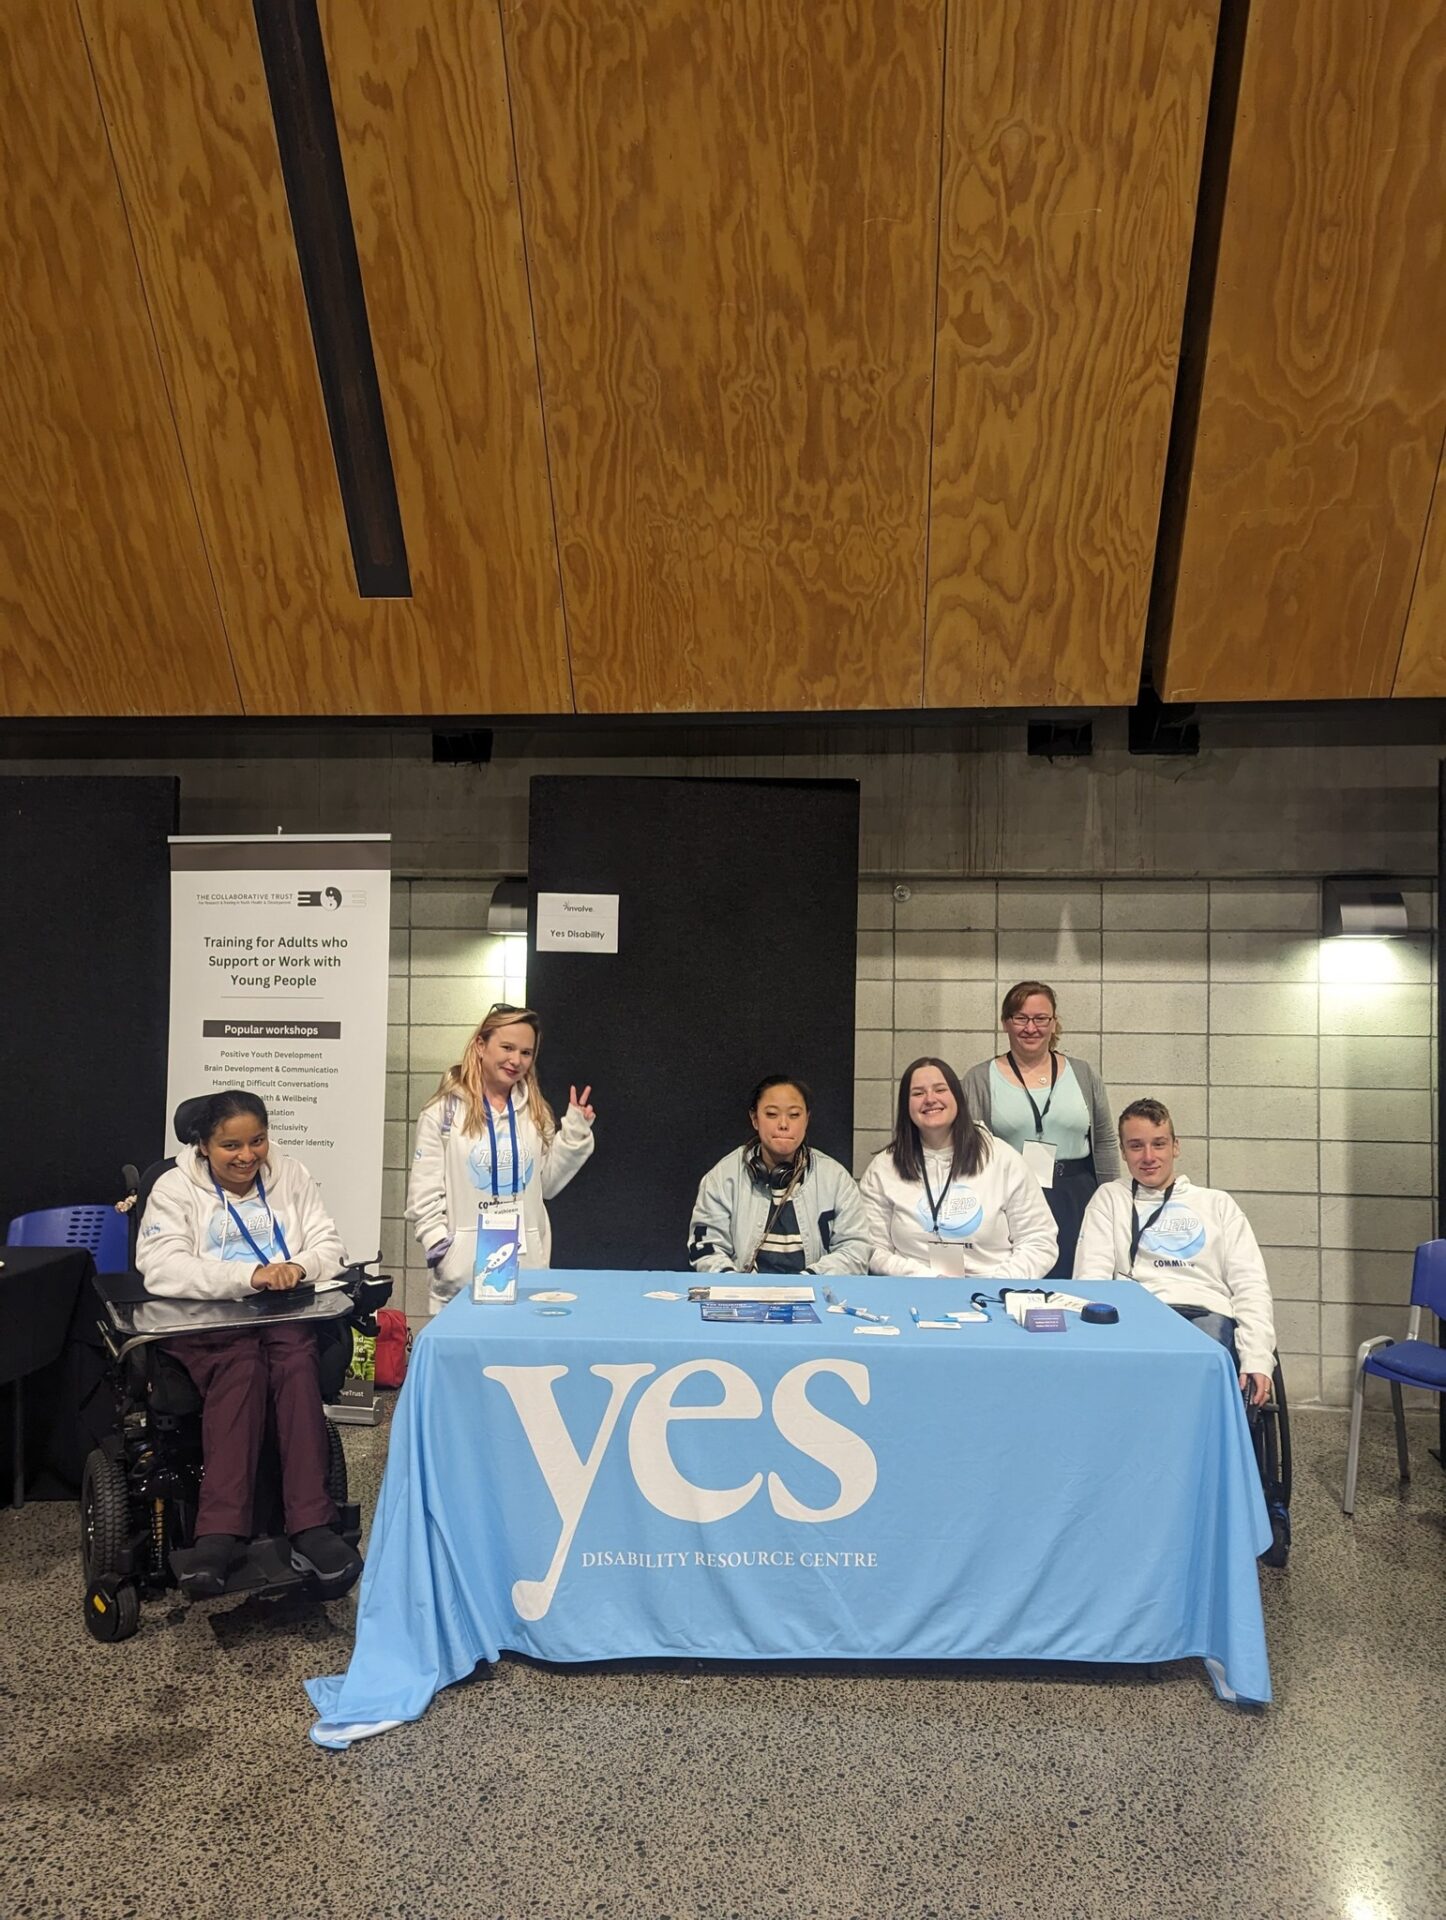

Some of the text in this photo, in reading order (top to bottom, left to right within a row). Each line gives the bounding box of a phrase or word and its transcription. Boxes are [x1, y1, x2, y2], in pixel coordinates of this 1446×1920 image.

[550, 929, 565, 938] Yes
[204, 936, 348, 950] Training for Adults who
[208, 955, 341, 969] Support or Work with
[230, 974, 317, 988] Young People
[224, 1024, 318, 1037] Popular workshops
[220, 1050, 322, 1060] Positive Youth Development
[204, 1064, 339, 1073] Brain Development & Communication
[212, 1079, 329, 1088] Handling Difficult Conversations
[260, 1093, 318, 1105] alth & Wellbeing
[270, 1123, 308, 1133] Inclusivity
[277, 1137, 335, 1149] Gender Identity
[1153, 1259, 1195, 1268] COMMI
[482, 1358, 878, 1621] yes
[581, 1551, 878, 1569] DISABILITY RESOURCE CENTRE
